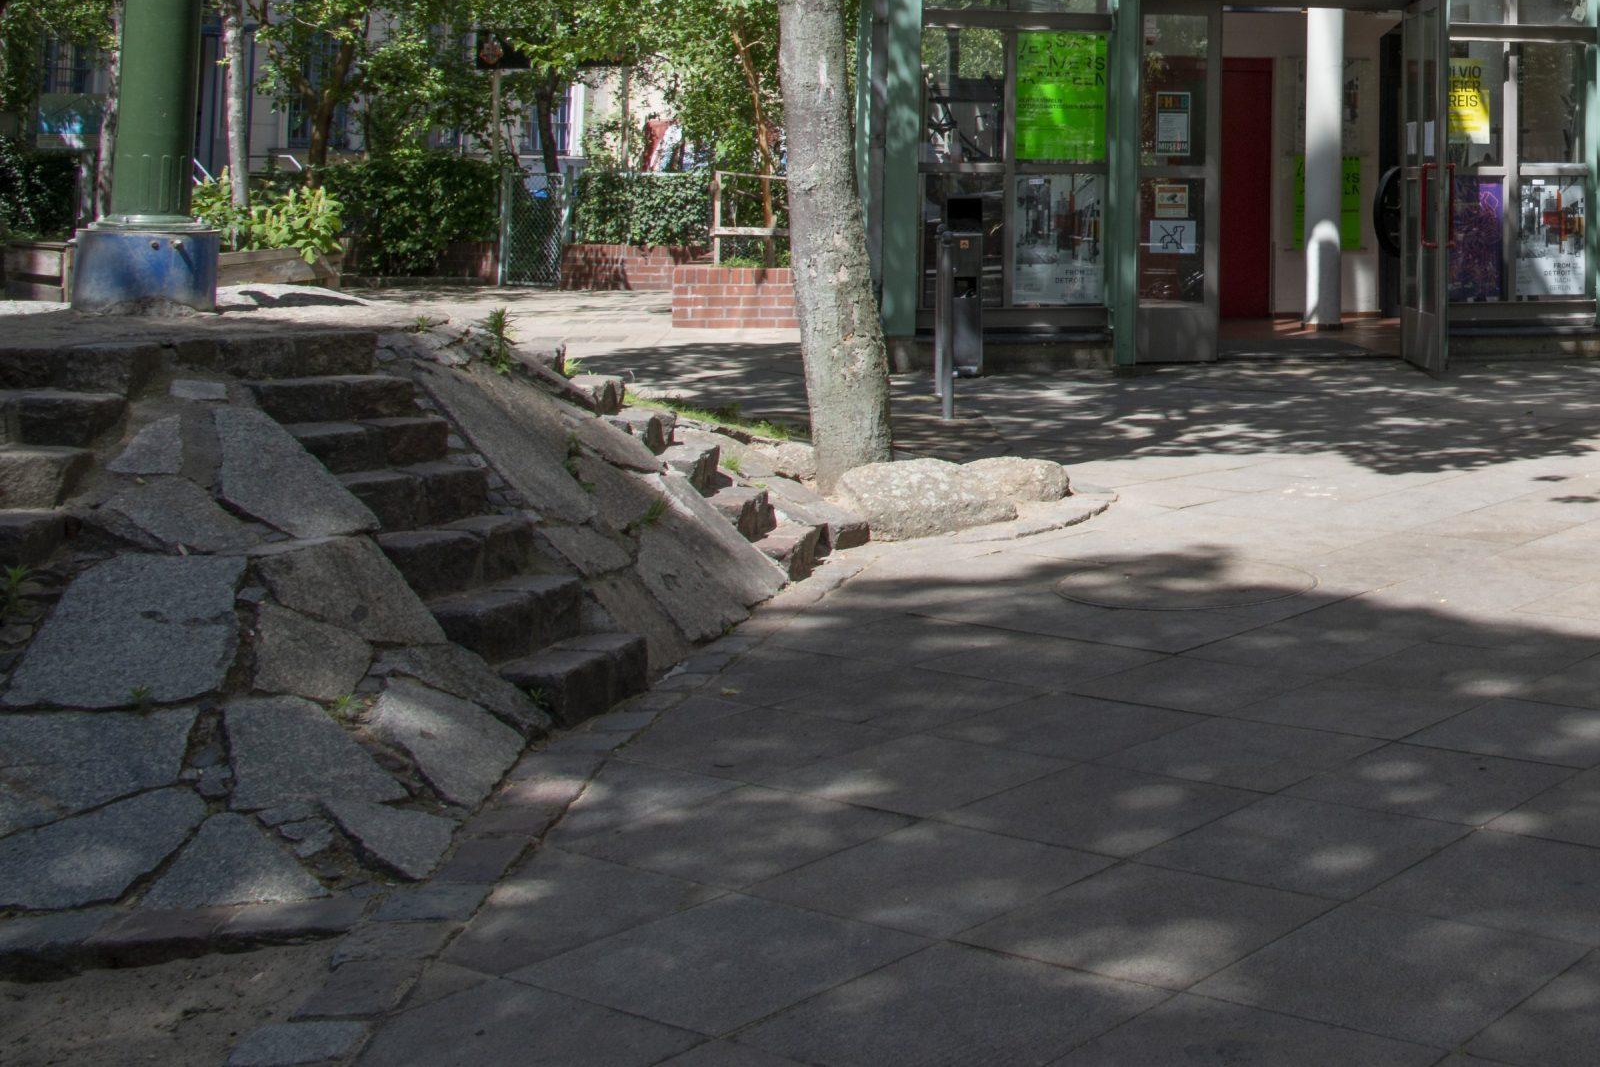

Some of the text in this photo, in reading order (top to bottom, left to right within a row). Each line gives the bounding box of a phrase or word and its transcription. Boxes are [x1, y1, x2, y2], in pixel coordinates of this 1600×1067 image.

[1449, 79, 1481, 93] EIER
[1449, 94, 1478, 108] REIS
[1158, 141, 1188, 151] MUSEUM
